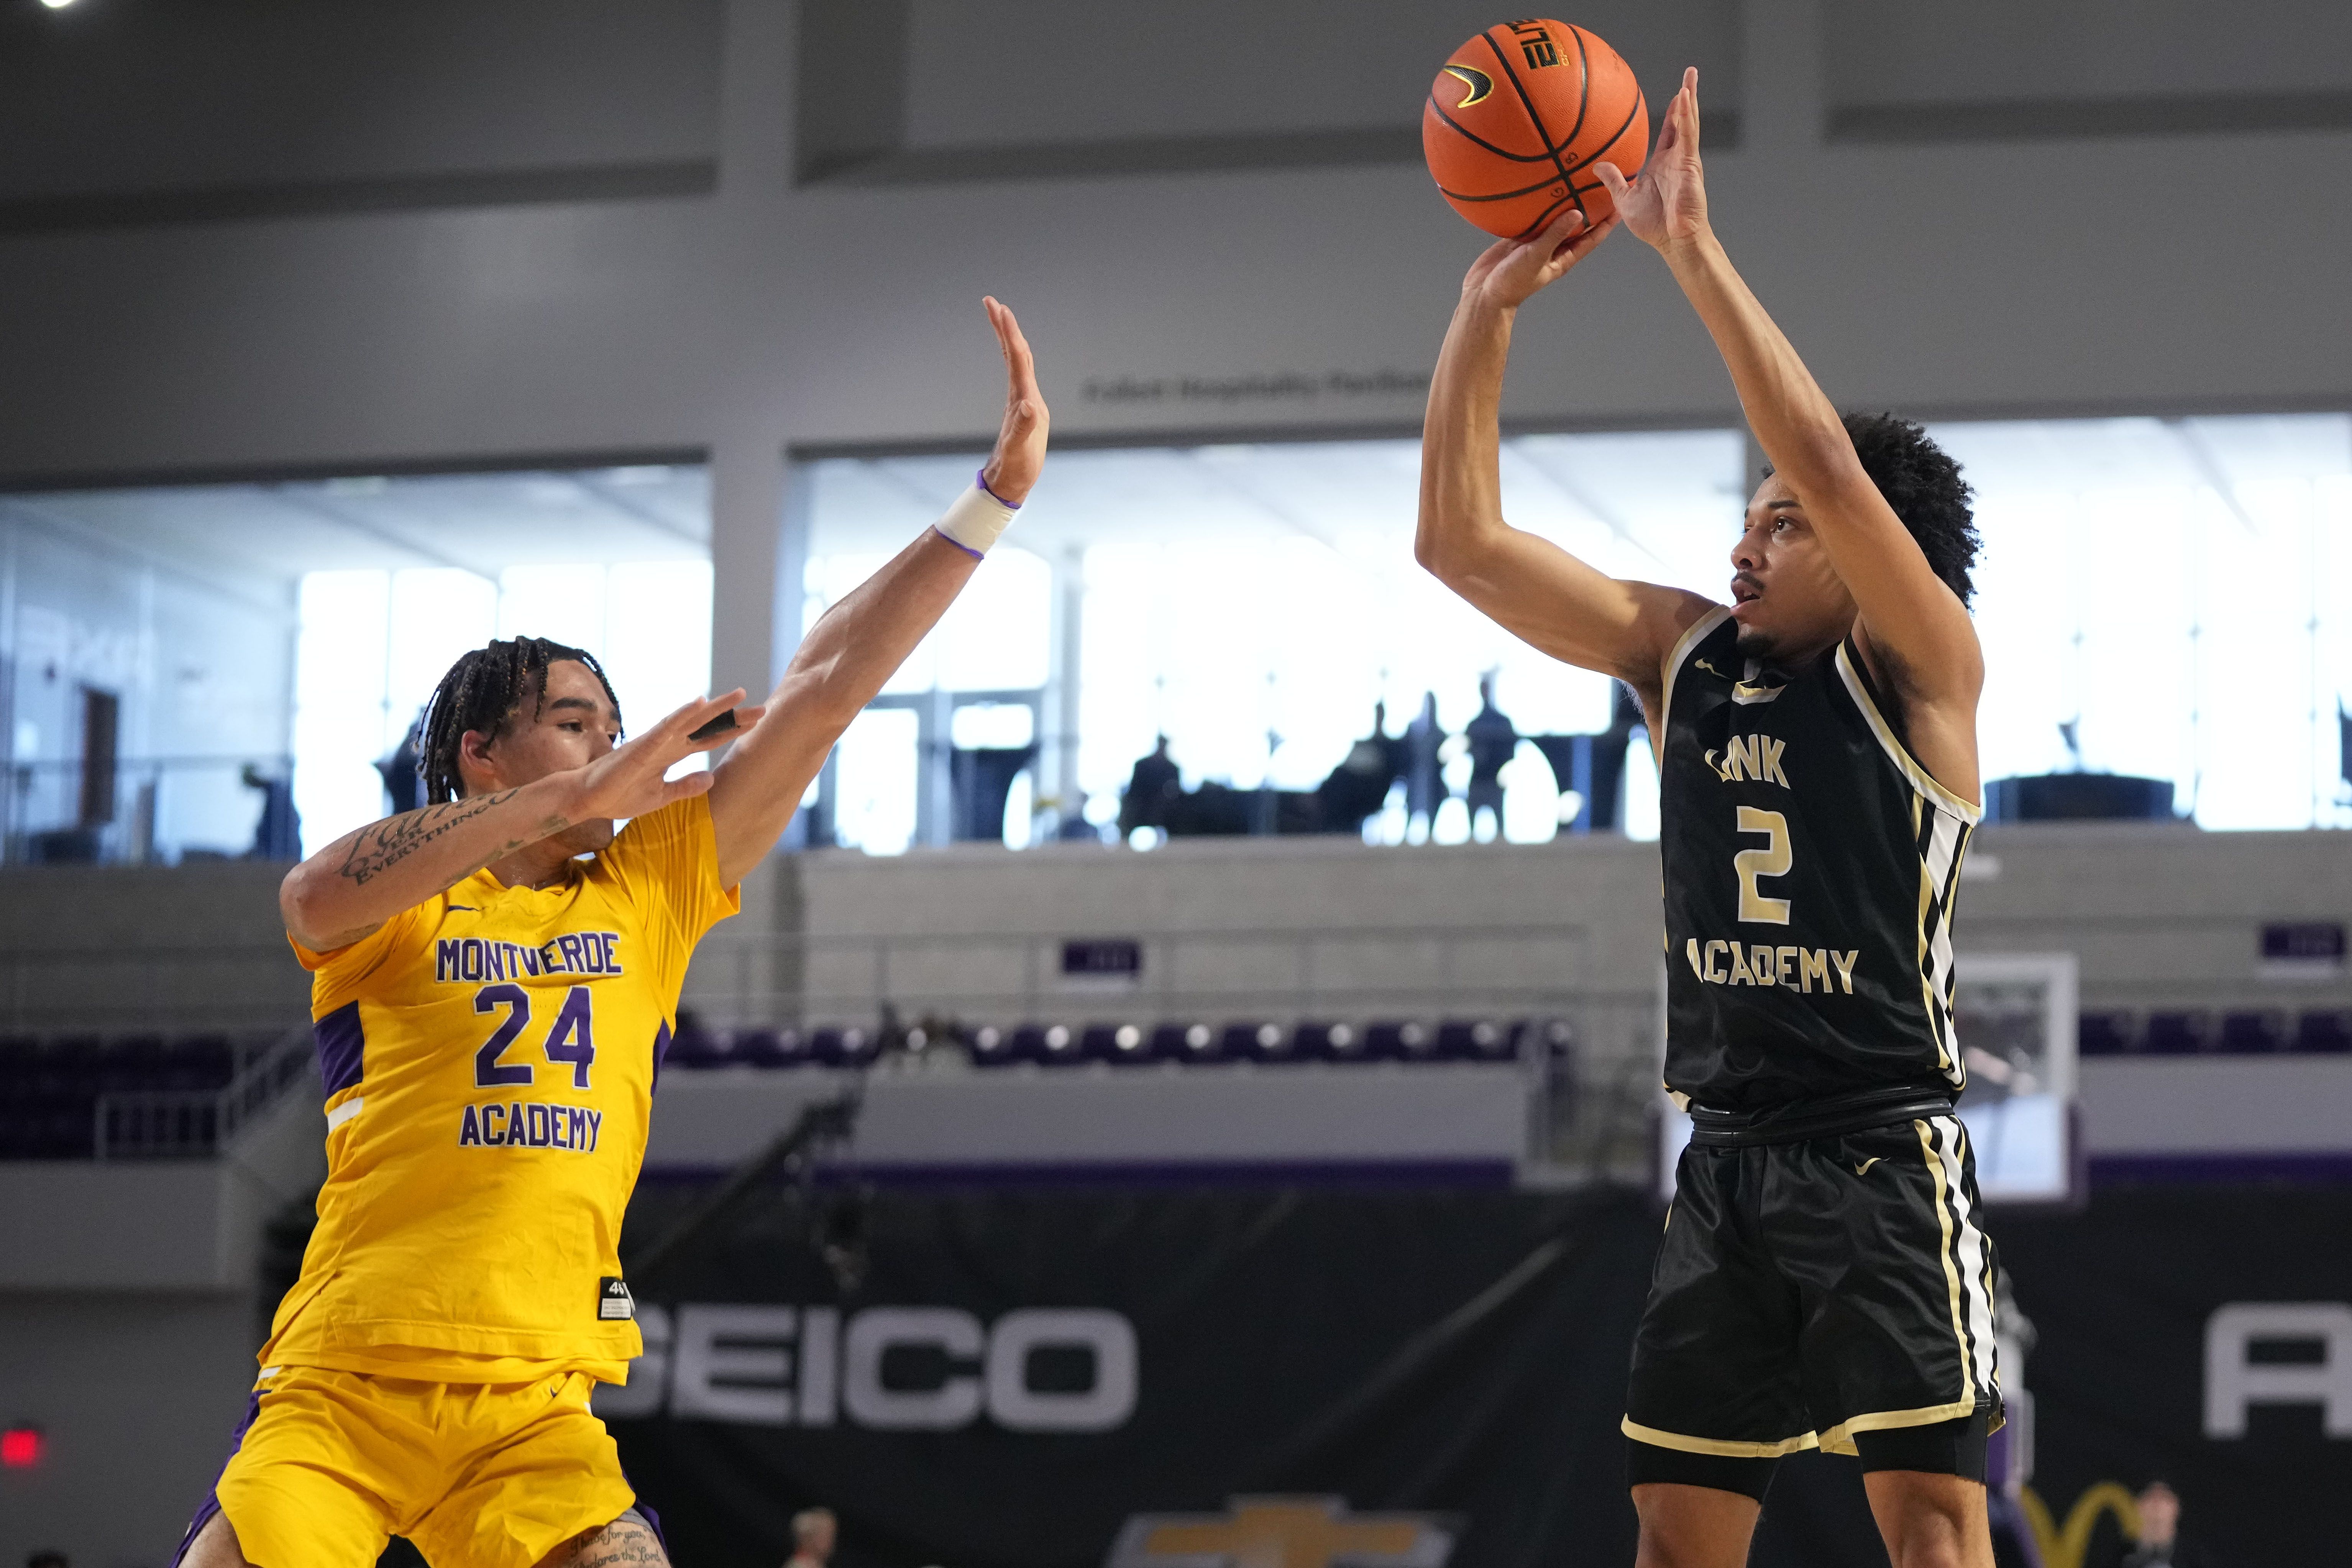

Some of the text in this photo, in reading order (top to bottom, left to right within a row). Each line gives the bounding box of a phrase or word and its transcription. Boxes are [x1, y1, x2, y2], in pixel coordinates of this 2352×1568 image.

[1733, 805, 1793, 925] 2
[435, 931, 624, 983] MONTVERDE
[473, 982, 597, 1090] 24
[458, 1101, 602, 1154] ACADEMY
